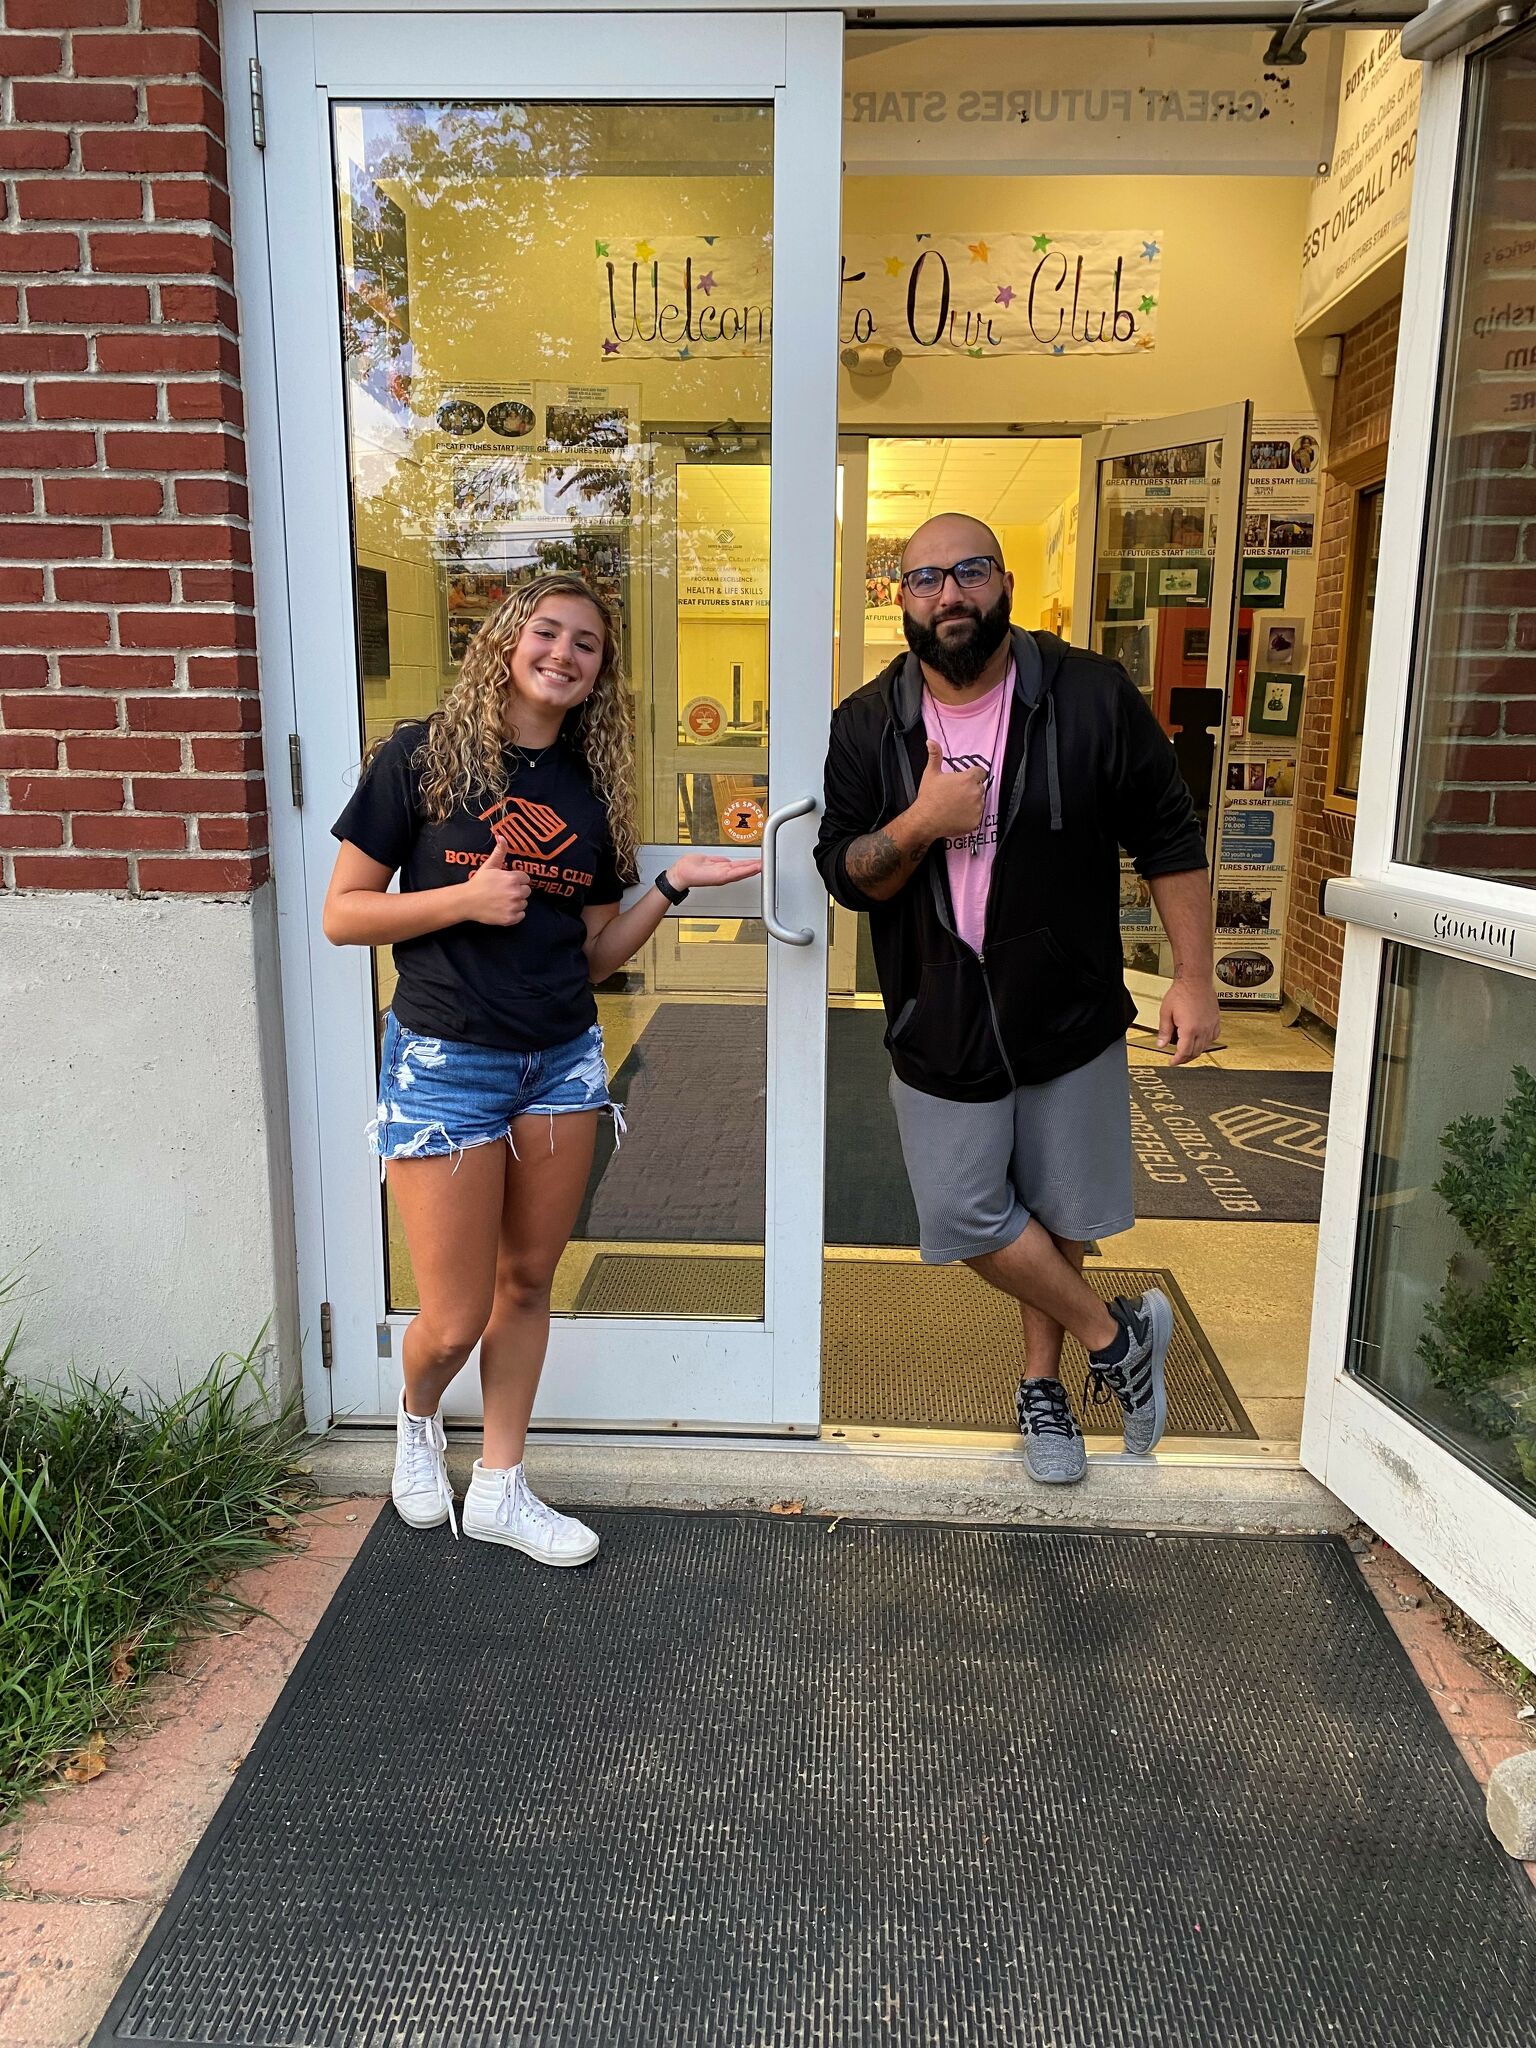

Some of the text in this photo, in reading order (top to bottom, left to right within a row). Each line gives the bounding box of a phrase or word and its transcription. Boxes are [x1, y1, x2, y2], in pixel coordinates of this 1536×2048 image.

[1332, 165, 1385, 242] OVERALL
[605, 256, 772, 345] Welcom
[907, 250, 1003, 347] Our
[1028, 250, 1141, 345] Club
[493, 444, 515, 452] START
[1106, 479, 1130, 487] GREAT
[1130, 478, 1164, 486] FUTURES
[1164, 478, 1188, 486] START
[1249, 477, 1270, 485] URES
[1271, 477, 1295, 485] START
[1127, 549, 1160, 557] FUTURES
[1243, 548, 1266, 556] TURES
[1267, 548, 1290, 556] START
[686, 586, 764, 596] HEALTH & LIFE SKILLS
[678, 598, 697, 606] REAT
[731, 599, 754, 607] START
[724, 800, 764, 820] SAFE SPACE
[727, 827, 758, 840] RIDGEFIELD
[445, 849, 487, 867] BOYS
[511, 859, 559, 877] GIRLS
[562, 868, 594, 887] CLUB
[529, 879, 575, 898] EFIELD
[1128, 1067, 1262, 1212] BOYS & GIRLS CLUB
[1130, 1101, 1188, 1183] IDGEFIELD
